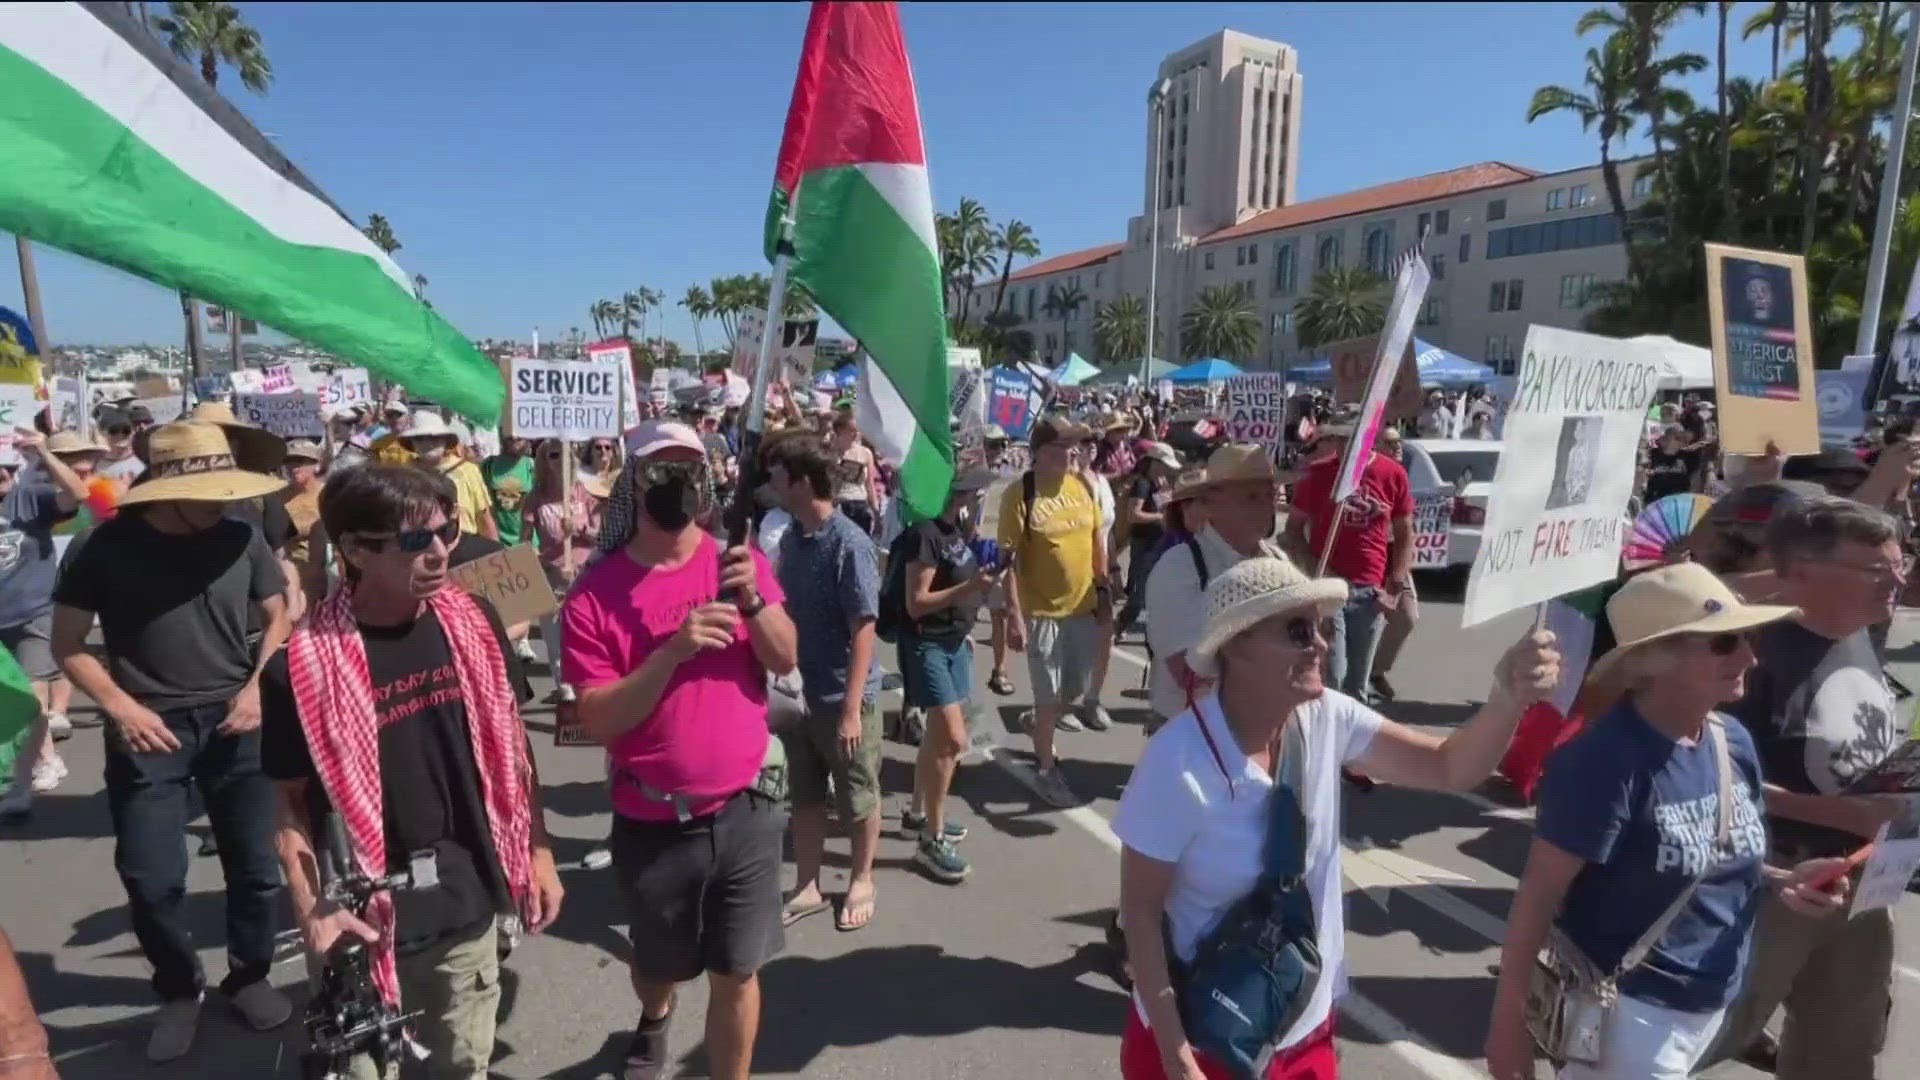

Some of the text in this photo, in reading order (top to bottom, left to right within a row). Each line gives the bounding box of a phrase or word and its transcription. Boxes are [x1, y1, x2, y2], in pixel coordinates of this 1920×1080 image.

[517, 369, 614, 396] SERVICE
[1230, 376, 1279, 391] WHICH
[1515, 350, 1658, 413] PAY WORKERS
[1743, 361, 1785, 383] FIRST
[1232, 393, 1279, 407] SIDE
[517, 405, 613, 429] CELEBRITY
[1233, 408, 1280, 422] ARE
[1233, 424, 1278, 439] YOU
[1486, 529, 1523, 573] NOT
[1530, 519, 1575, 566] FIRE
[497, 572, 529, 599] NO
